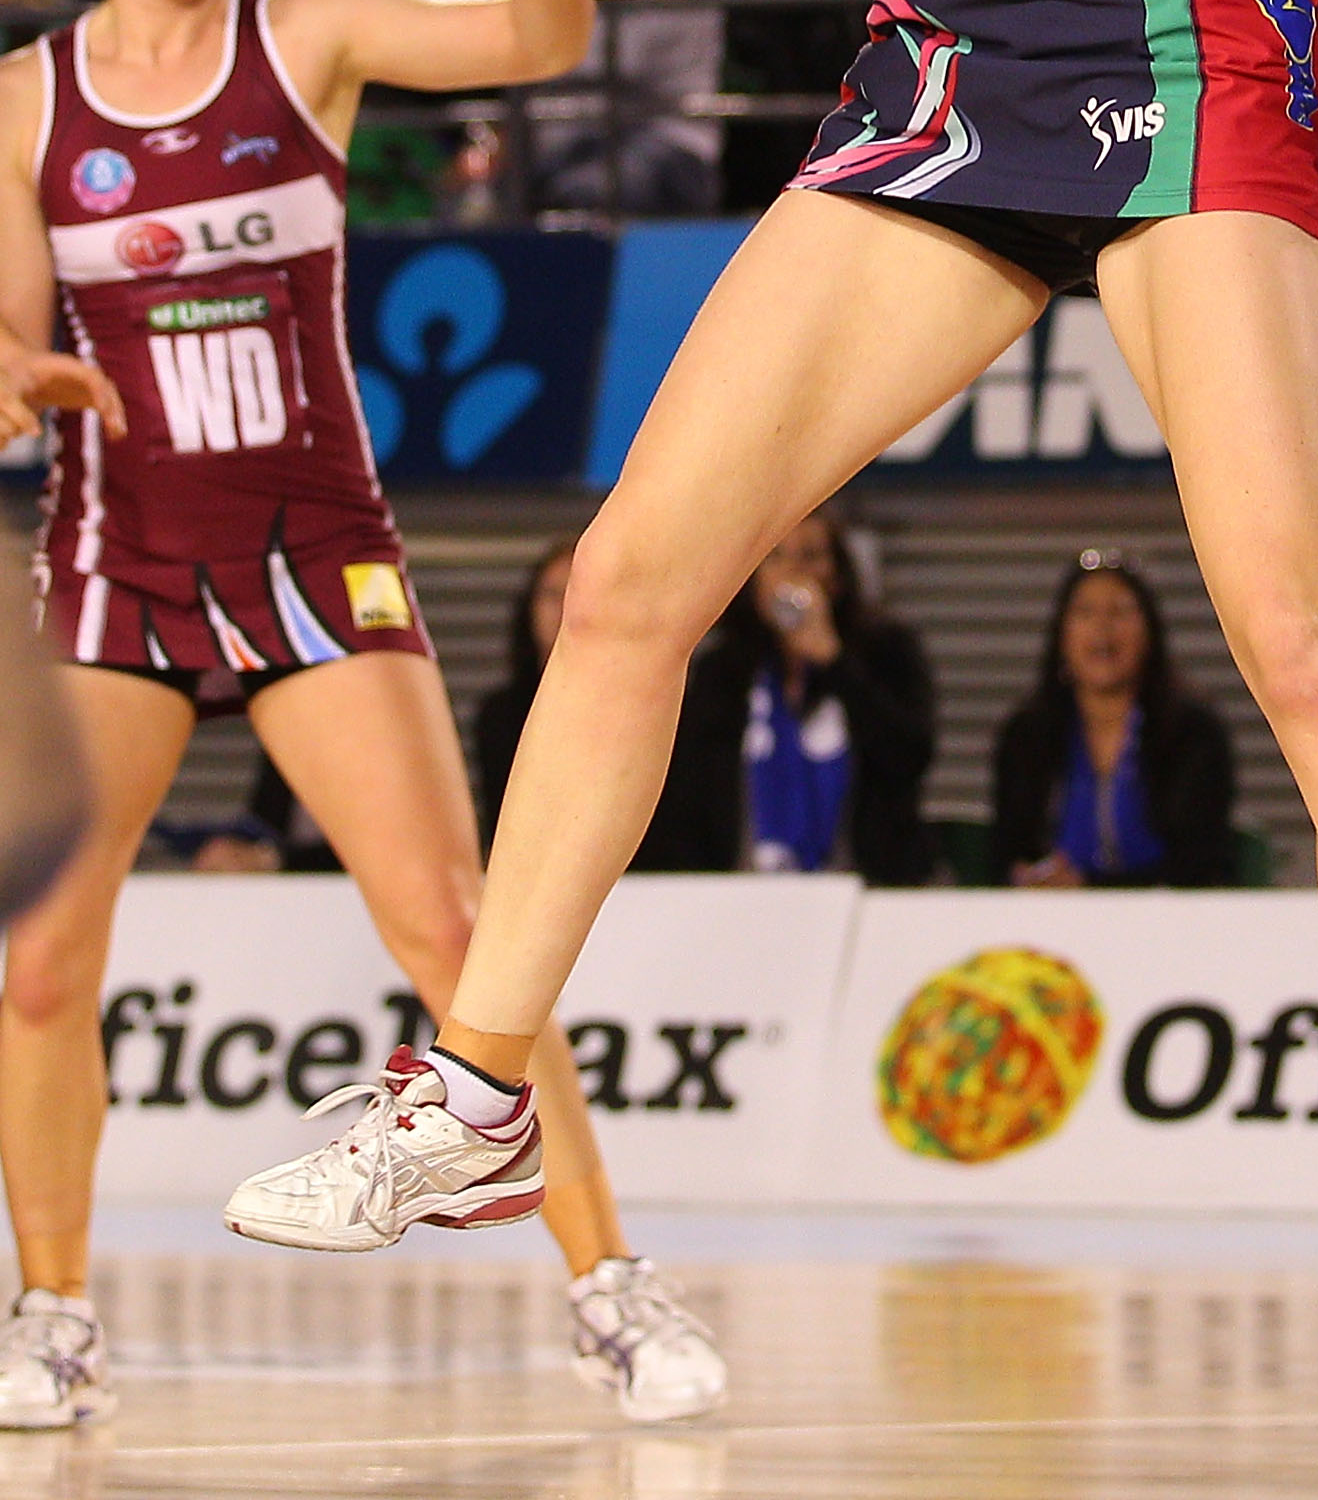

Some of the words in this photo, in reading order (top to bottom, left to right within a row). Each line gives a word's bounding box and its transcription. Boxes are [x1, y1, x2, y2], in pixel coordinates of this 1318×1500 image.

[1109, 101, 1166, 145] VIS
[199, 213, 273, 253] LG
[148, 326, 288, 455] WD
